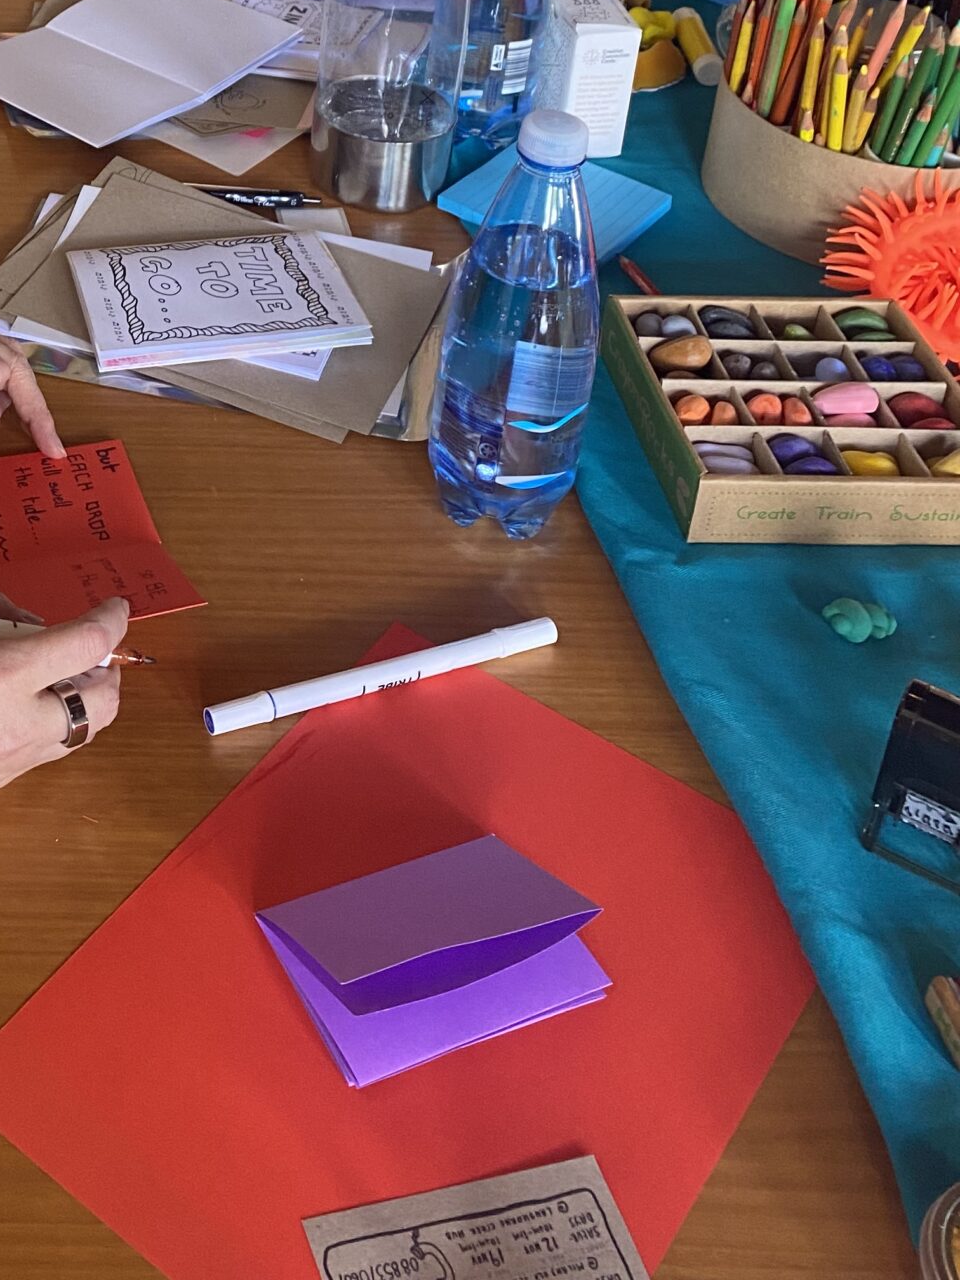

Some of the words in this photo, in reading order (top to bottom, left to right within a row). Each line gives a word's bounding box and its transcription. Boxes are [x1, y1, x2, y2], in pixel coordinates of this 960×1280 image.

[195, 260, 239, 299] TO
[234, 246, 292, 314] TIME
[41, 457, 63, 477] will
[96, 447, 117, 473] but
[14, 466, 34, 489] the
[48, 481, 72, 508] swell
[66, 453, 94, 492] EACH
[85, 500, 110, 542] DROP
[736, 505, 797, 520] Create
[815, 505, 873, 520] Train
[557, 1200, 570, 1214] @
[540, 1236, 559, 1253] 12
[489, 1247, 505, 1267] 19
[586, 1256, 599, 1271] @
